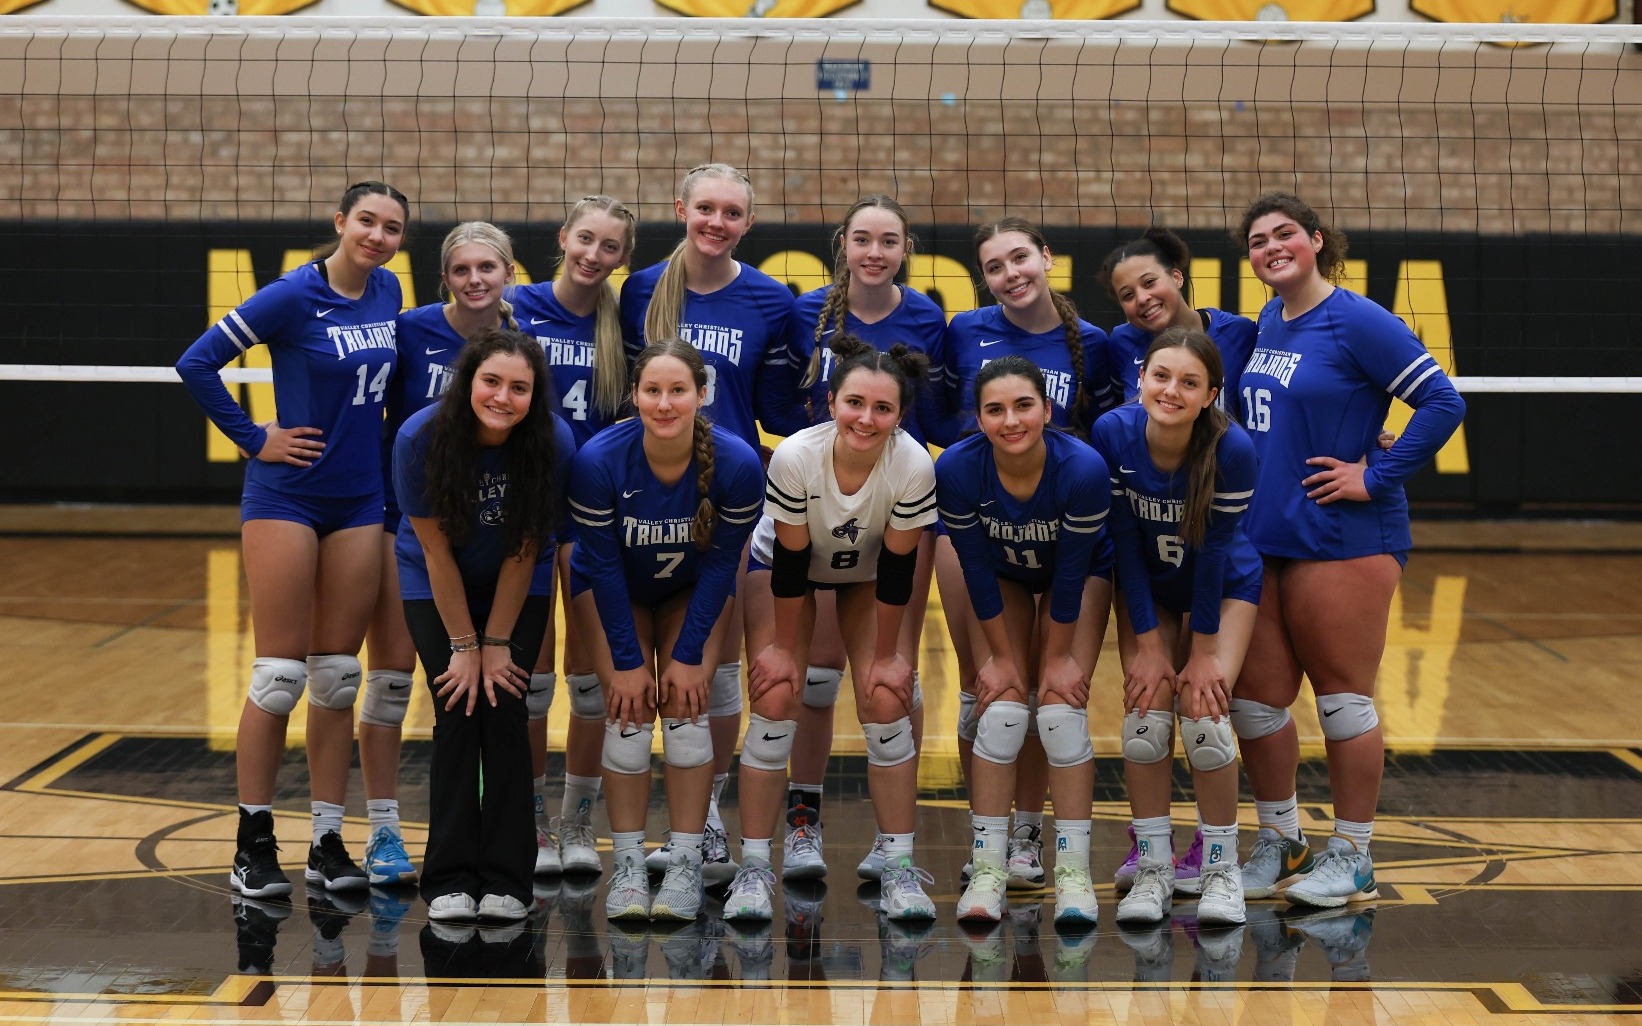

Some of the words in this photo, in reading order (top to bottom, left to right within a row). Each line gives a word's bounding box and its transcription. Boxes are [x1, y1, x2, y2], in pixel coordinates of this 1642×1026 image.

[550, 337, 575, 345] VALLEY
[694, 323, 729, 331] CHRISTIAN
[536, 335, 598, 368] TROJA
[352, 361, 391, 406] 14
[562, 379, 588, 421] 4
[1242, 386, 1272, 433] 16
[1126, 487, 1185, 522] TROJA
[1137, 493, 1161, 503] VALLEY
[622, 516, 697, 548] TROJA
[664, 516, 696, 524] CHRISTIA
[653, 551, 685, 579] 7
[830, 549, 861, 570] 8
[1003, 545, 1042, 569] 11
[1156, 534, 1185, 569] 6
